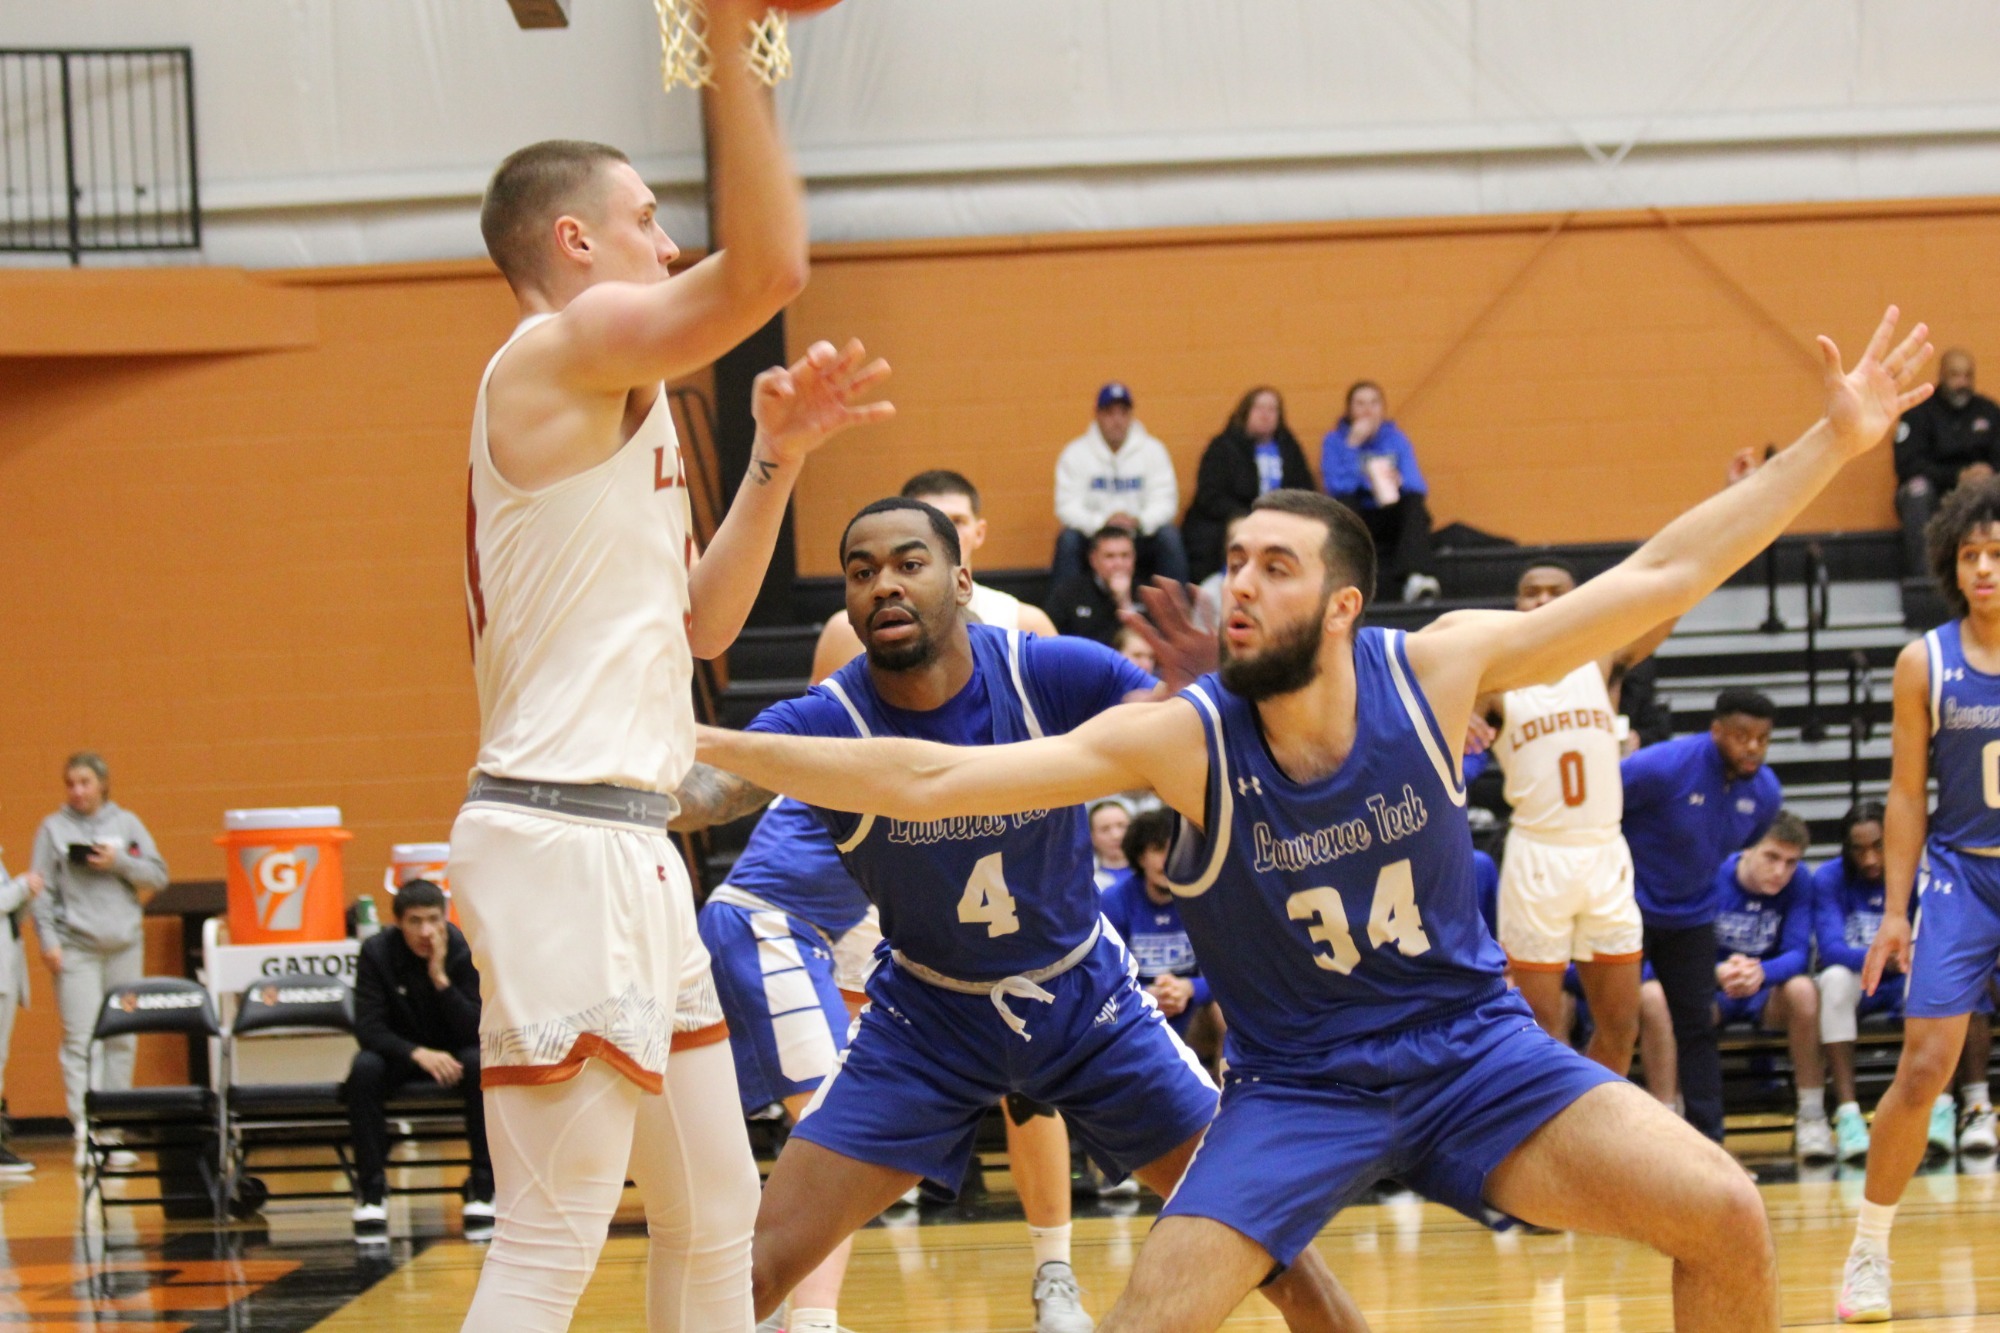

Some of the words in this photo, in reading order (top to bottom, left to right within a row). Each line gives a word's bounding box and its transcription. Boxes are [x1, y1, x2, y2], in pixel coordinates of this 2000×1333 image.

[1559, 751, 1586, 807] 0
[1254, 821, 1372, 873] Lawrence
[1366, 784, 1428, 844] Tech
[259, 853, 297, 893] G
[957, 851, 1020, 938] 4
[1286, 858, 1432, 976] 34
